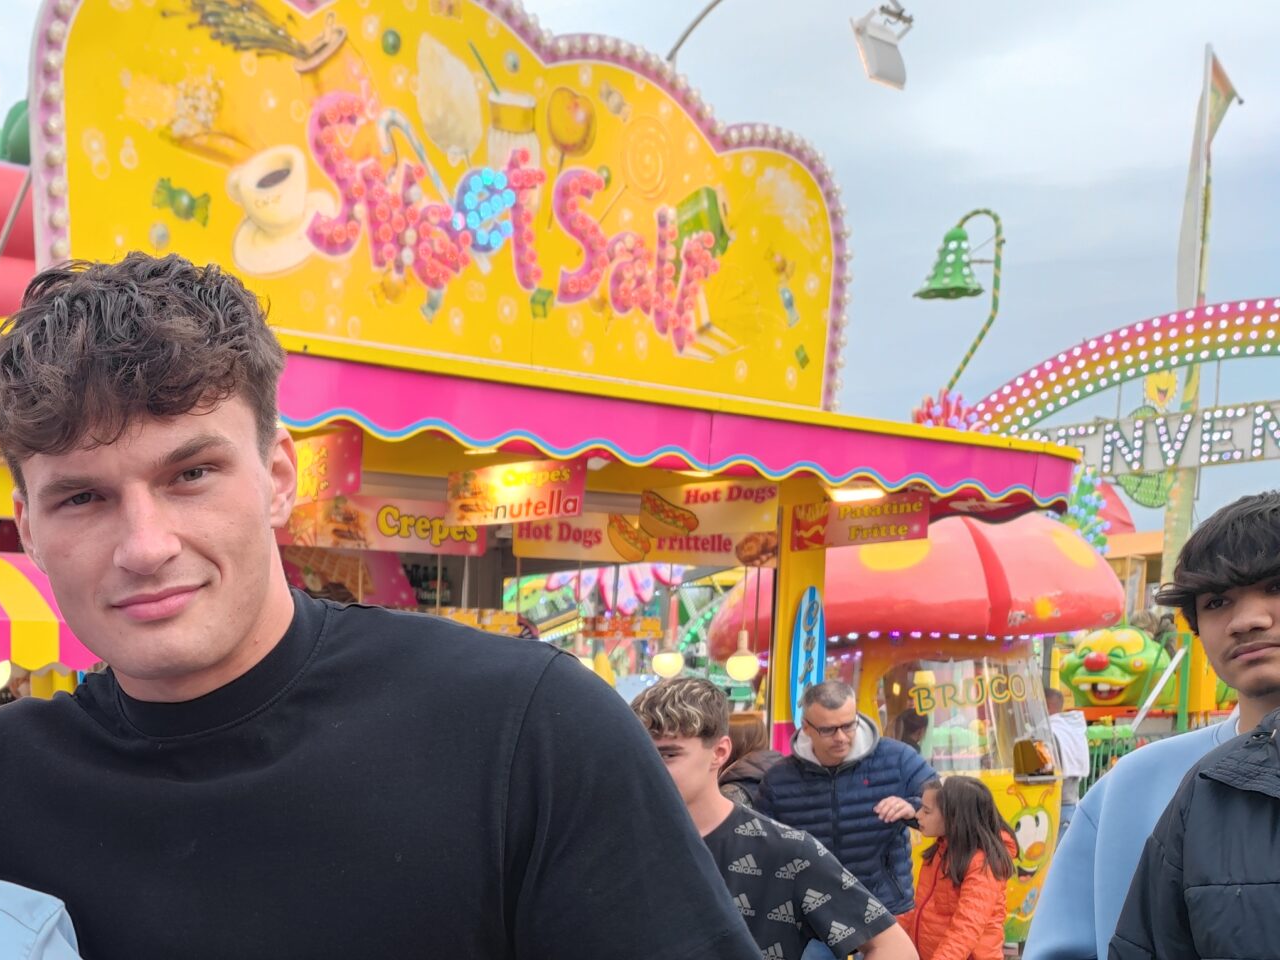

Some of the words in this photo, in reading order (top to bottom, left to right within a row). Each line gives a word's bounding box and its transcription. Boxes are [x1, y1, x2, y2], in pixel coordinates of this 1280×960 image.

[1020, 403, 1280, 476] ENVEN
[494, 489, 579, 520] nutella
[684, 486, 722, 505] Hot
[726, 485, 778, 504] Dogs
[838, 500, 923, 520] Patatine
[517, 521, 553, 541] Hot
[558, 521, 603, 548] Dogs
[848, 523, 910, 541] Fritte
[657, 533, 733, 553] Frittelle
[734, 827, 768, 838] adidas
[728, 864, 763, 877] adidas
[828, 926, 856, 947] adidas
